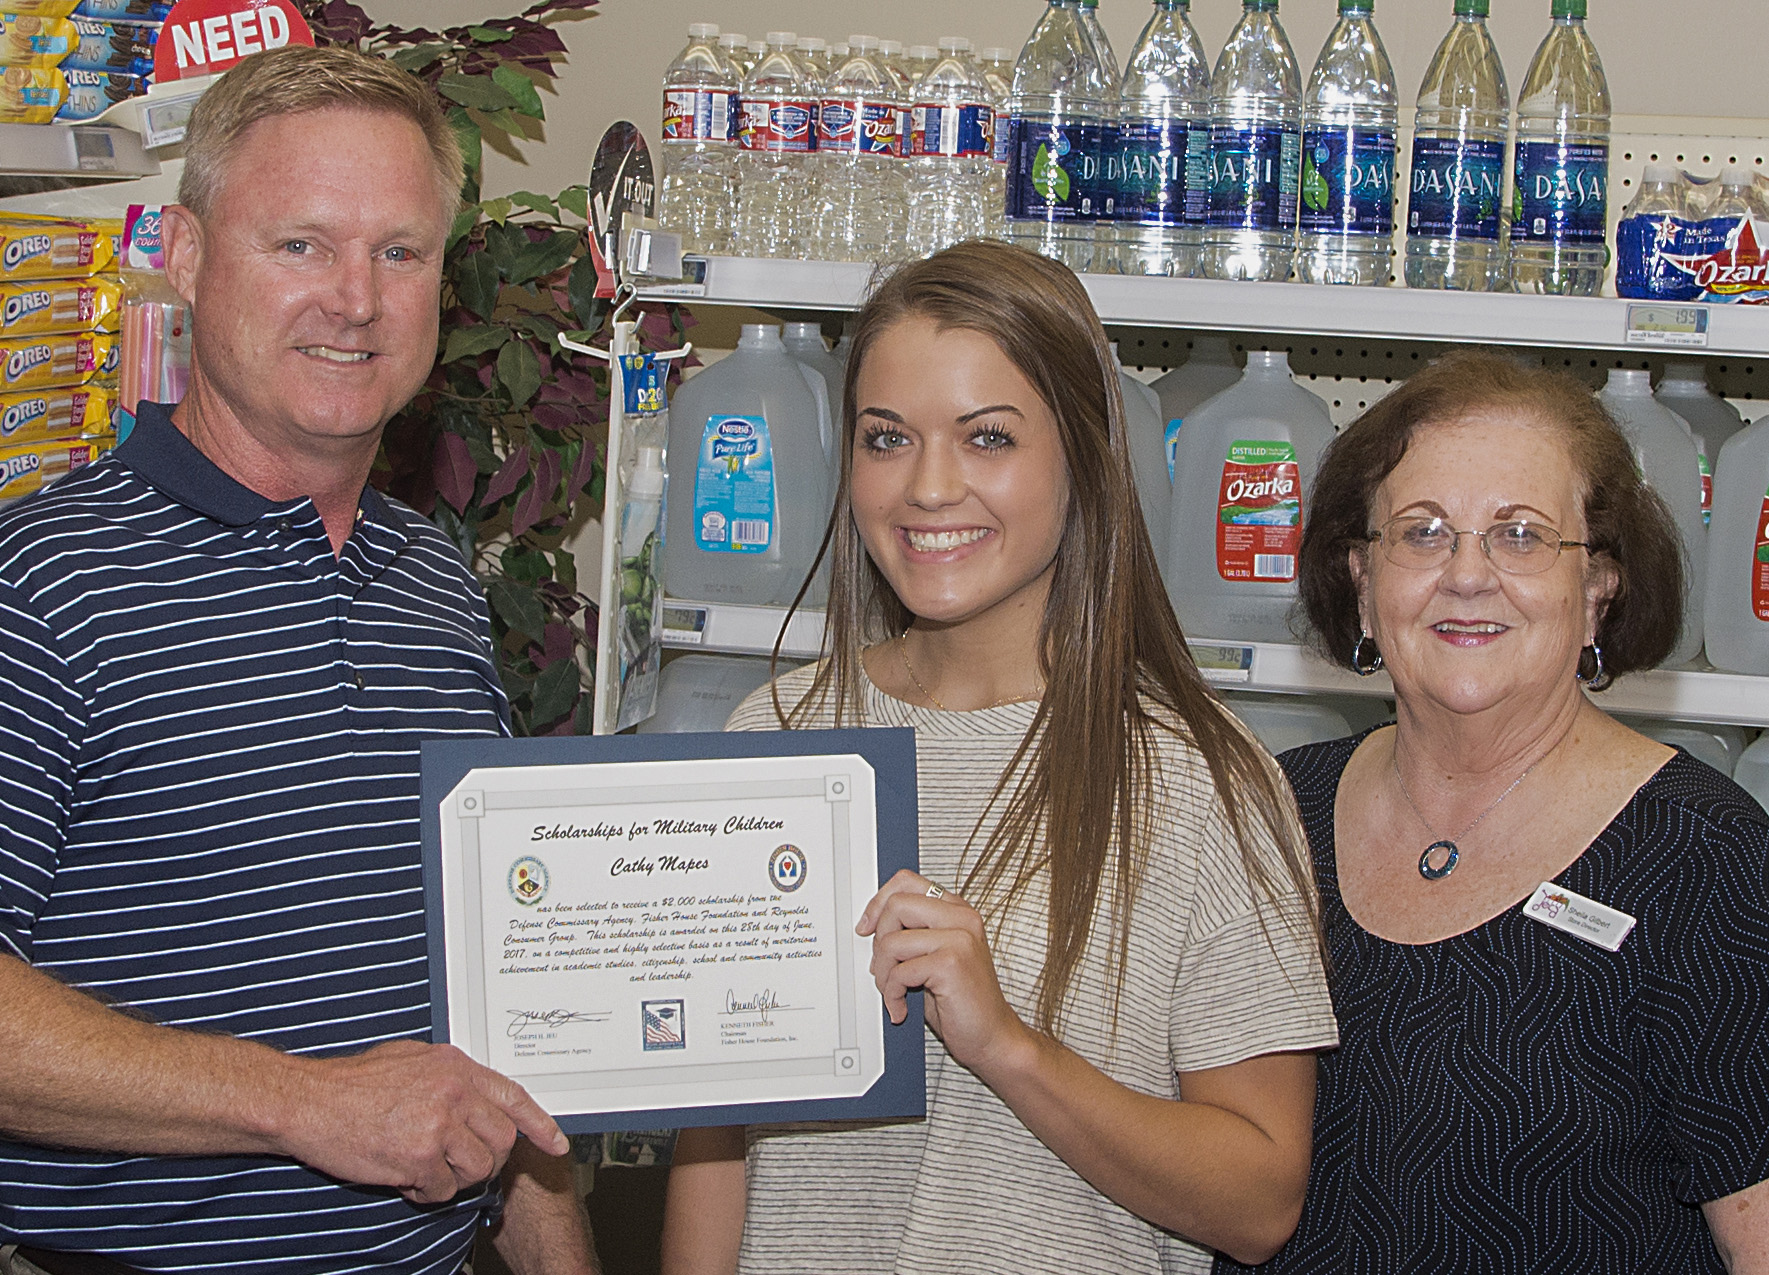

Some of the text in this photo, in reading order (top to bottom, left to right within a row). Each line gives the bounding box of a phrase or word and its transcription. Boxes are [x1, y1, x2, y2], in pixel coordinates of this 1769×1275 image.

[171, 5, 290, 68] NEED
[1206, 151, 1272, 188] SANI
[1350, 158, 1394, 196] DAS
[1413, 162, 1501, 200] DASANI
[624, 176, 654, 207] IT OUT
[1535, 168, 1606, 207] DASA
[138, 215, 161, 235] 36
[1685, 227, 1712, 236] Made
[5, 236, 51, 265] OREO
[135, 237, 161, 247] coun
[1683, 236, 1725, 244] in Texas
[1694, 260, 1769, 287] Ozar
[6, 292, 51, 320] OREO
[9, 346, 51, 376] OREO
[4, 400, 46, 430] OREO
[1232, 447, 1266, 456] DISTILLED
[0, 454, 40, 484] OREO
[1227, 477, 1293, 501] Ozarka
[531, 816, 784, 842] Scholarships for Military Children
[610, 855, 709, 876] Cathy Mapes
[555, 903, 572, 912] been
[576, 901, 607, 911] selected
[611, 901, 619, 909] to
[622, 900, 649, 909] receive
[698, 894, 744, 905] scholarship
[747, 894, 766, 905] from
[509, 919, 543, 931] Defense
[546, 917, 599, 929] Commissary
[641, 912, 669, 923] Fisher
[671, 910, 698, 921] House
[700, 909, 748, 921] Foundation
[752, 907, 767, 917] and
[771, 906, 809, 917] Reynolds
[1567, 906, 1611, 930] Sheila Gilbert
[503, 934, 545, 946] Consumer
[586, 930, 606, 940] This
[609, 928, 655, 941] scholarship
[659, 929, 667, 937] is
[670, 925, 705, 936] awarded
[722, 923, 737, 933] this
[740, 921, 760, 932] 28th
[763, 921, 779, 933] day
[782, 920, 791, 932] of
[554, 947, 600, 958] competitive
[603, 944, 620, 954] and
[622, 942, 649, 956] highly
[652, 941, 685, 951] selective
[689, 939, 709, 949] basis
[735, 937, 759, 947] result
[761, 936, 770, 948] of
[772, 935, 817, 945] meritorious
[499, 963, 549, 974] achievement
[563, 960, 602, 971] academic
[692, 953, 717, 964] school
[720, 953, 736, 962] and
[739, 952, 783, 964] community
[785, 949, 823, 960] activities
[629, 973, 647, 982] and
